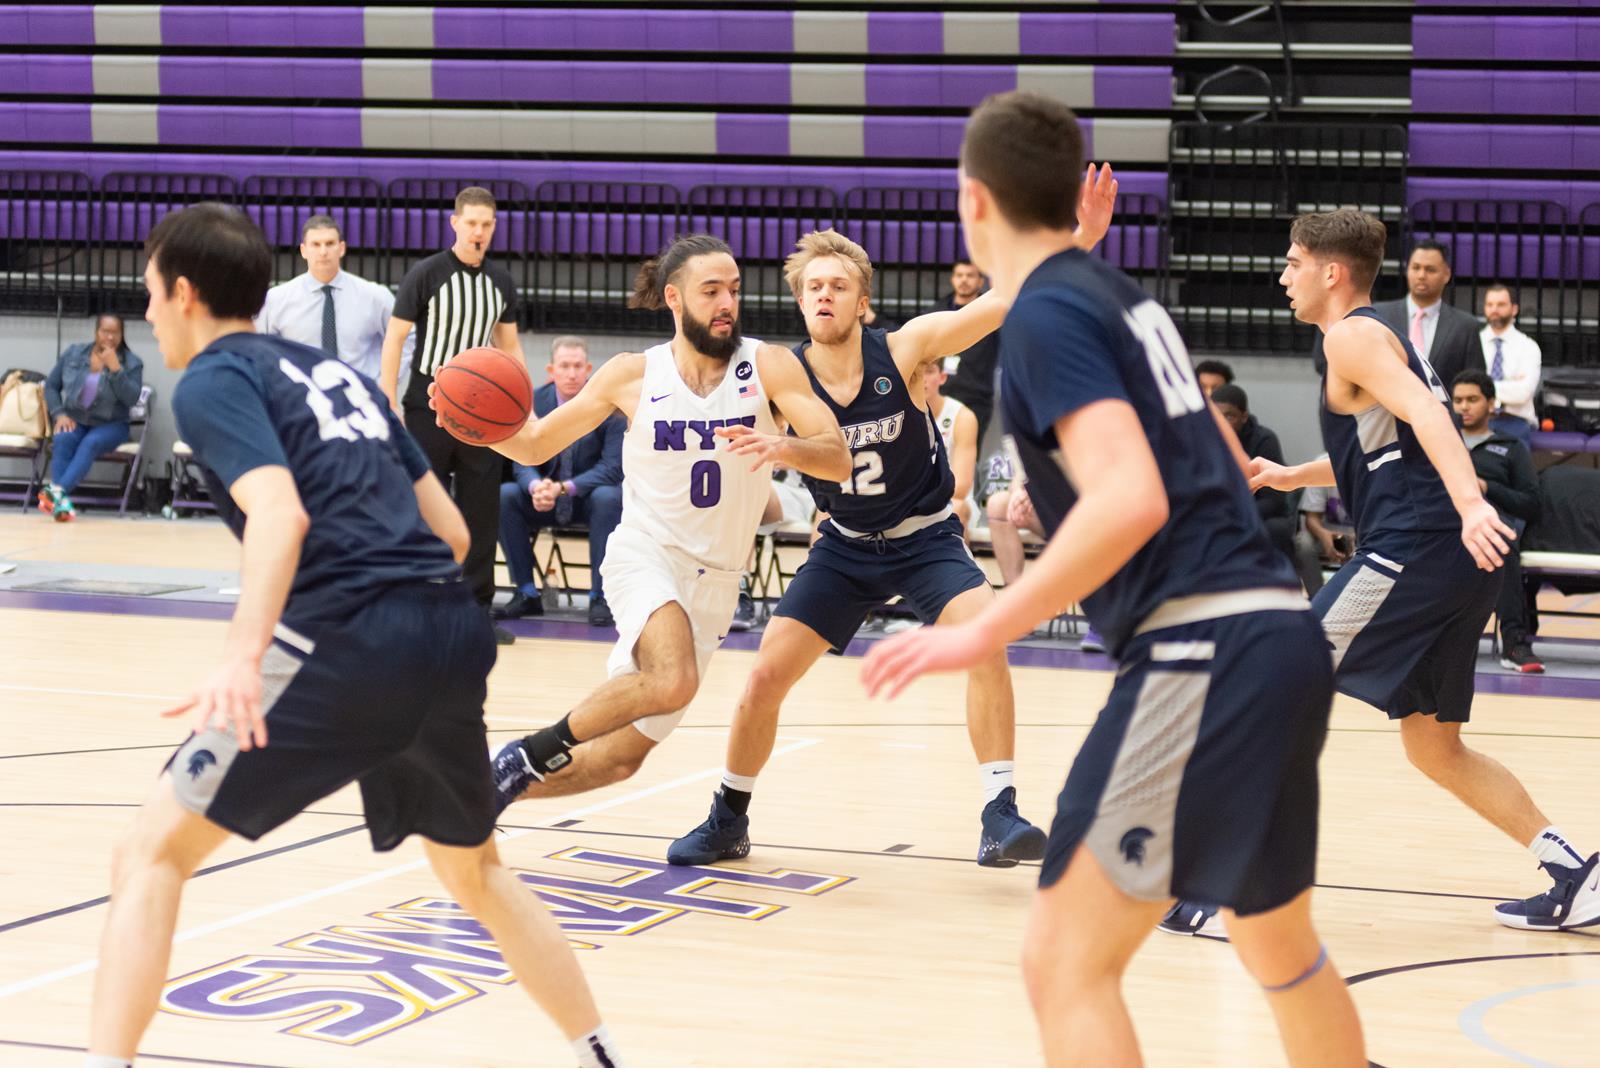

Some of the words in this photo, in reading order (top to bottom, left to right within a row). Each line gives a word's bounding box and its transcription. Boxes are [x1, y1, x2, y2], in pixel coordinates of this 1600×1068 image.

[279, 357, 390, 441] 13
[840, 410, 905, 449] RU
[690, 459, 721, 508] 0
